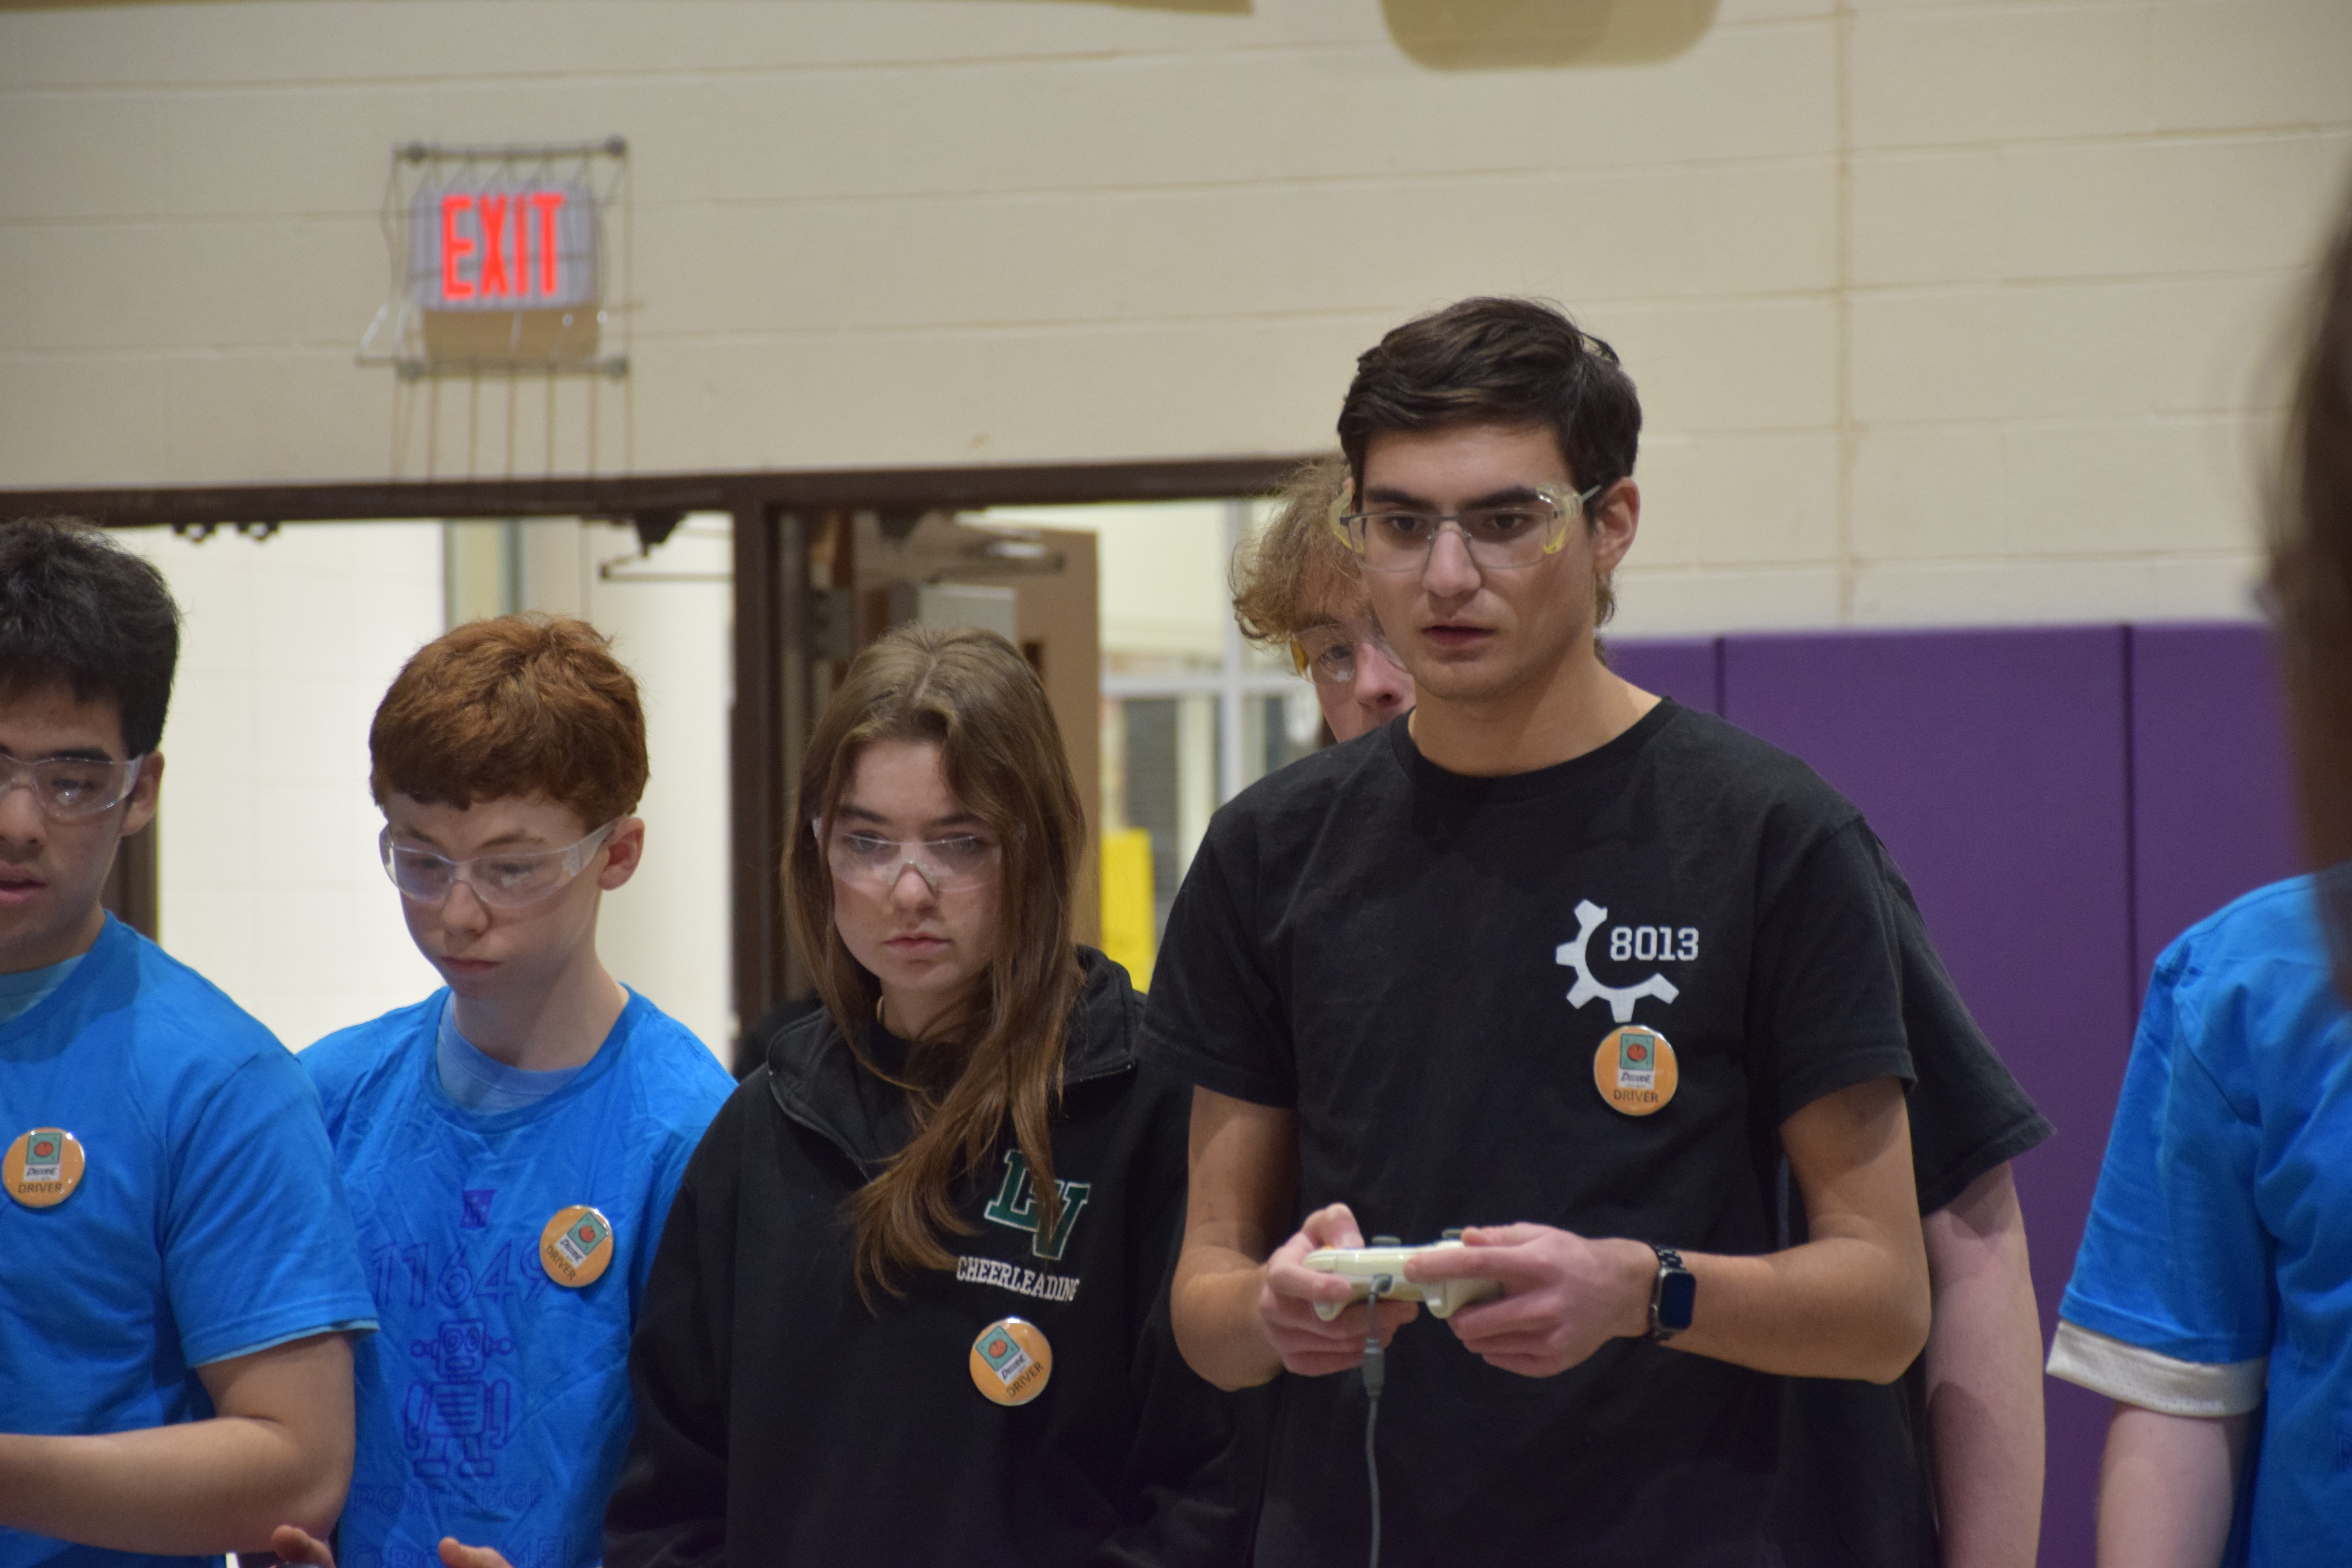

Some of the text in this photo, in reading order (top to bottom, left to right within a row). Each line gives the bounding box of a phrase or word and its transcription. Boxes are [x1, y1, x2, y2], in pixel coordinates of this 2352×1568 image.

[441, 193, 564, 299] EXIT
[1610, 926, 1699, 962] 8013
[1613, 1089, 1658, 1103] DRIVER
[18, 1183, 62, 1194] DRIVER
[545, 1244, 576, 1281] DRIVER
[956, 1255, 1080, 1302] CHEERLEADING
[1006, 1361, 1044, 1397] DRIVER
